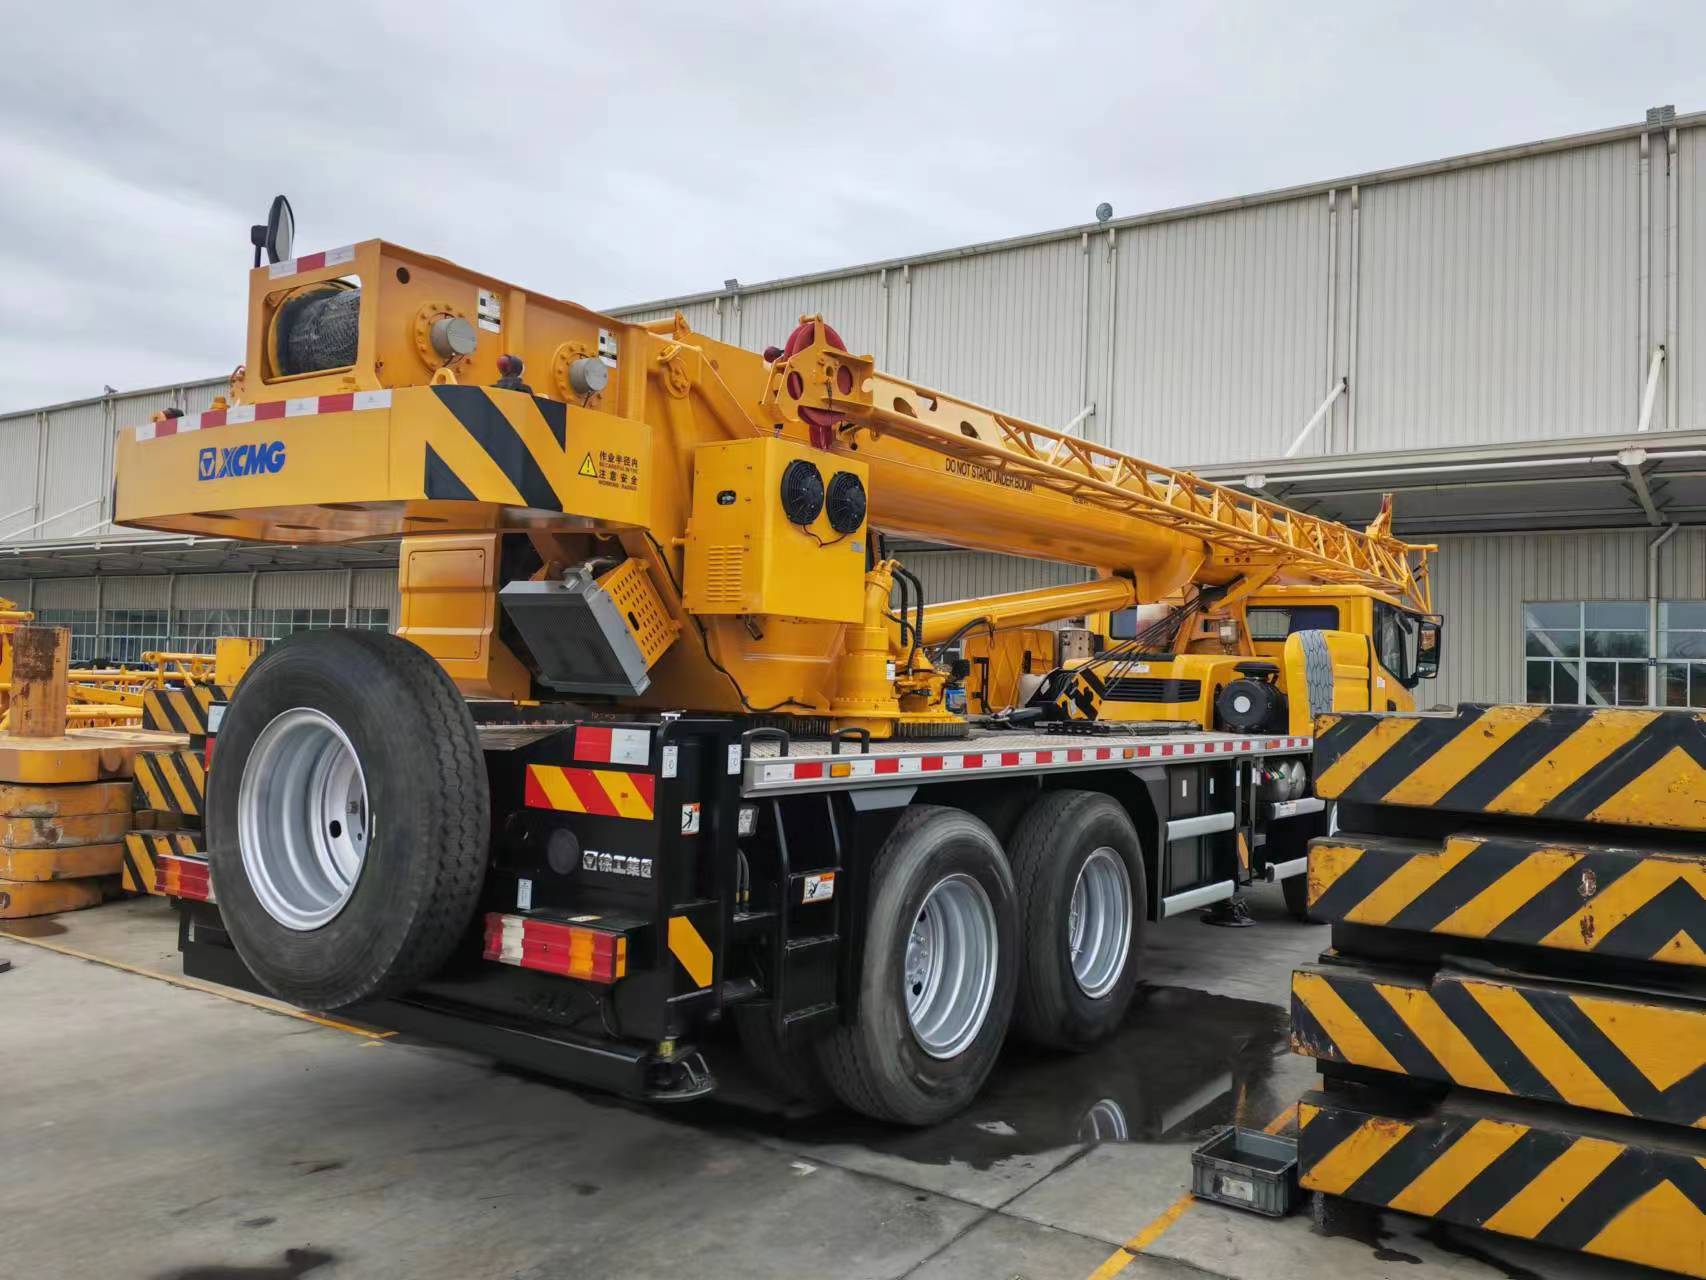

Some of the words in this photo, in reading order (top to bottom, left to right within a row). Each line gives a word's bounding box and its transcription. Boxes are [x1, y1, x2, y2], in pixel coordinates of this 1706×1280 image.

[217, 441, 286, 479] XCMG
[945, 457, 956, 473] DO
[956, 460, 971, 477] NOT
[971, 465, 992, 482] STAND
[599, 469, 638, 485] 注意安全
